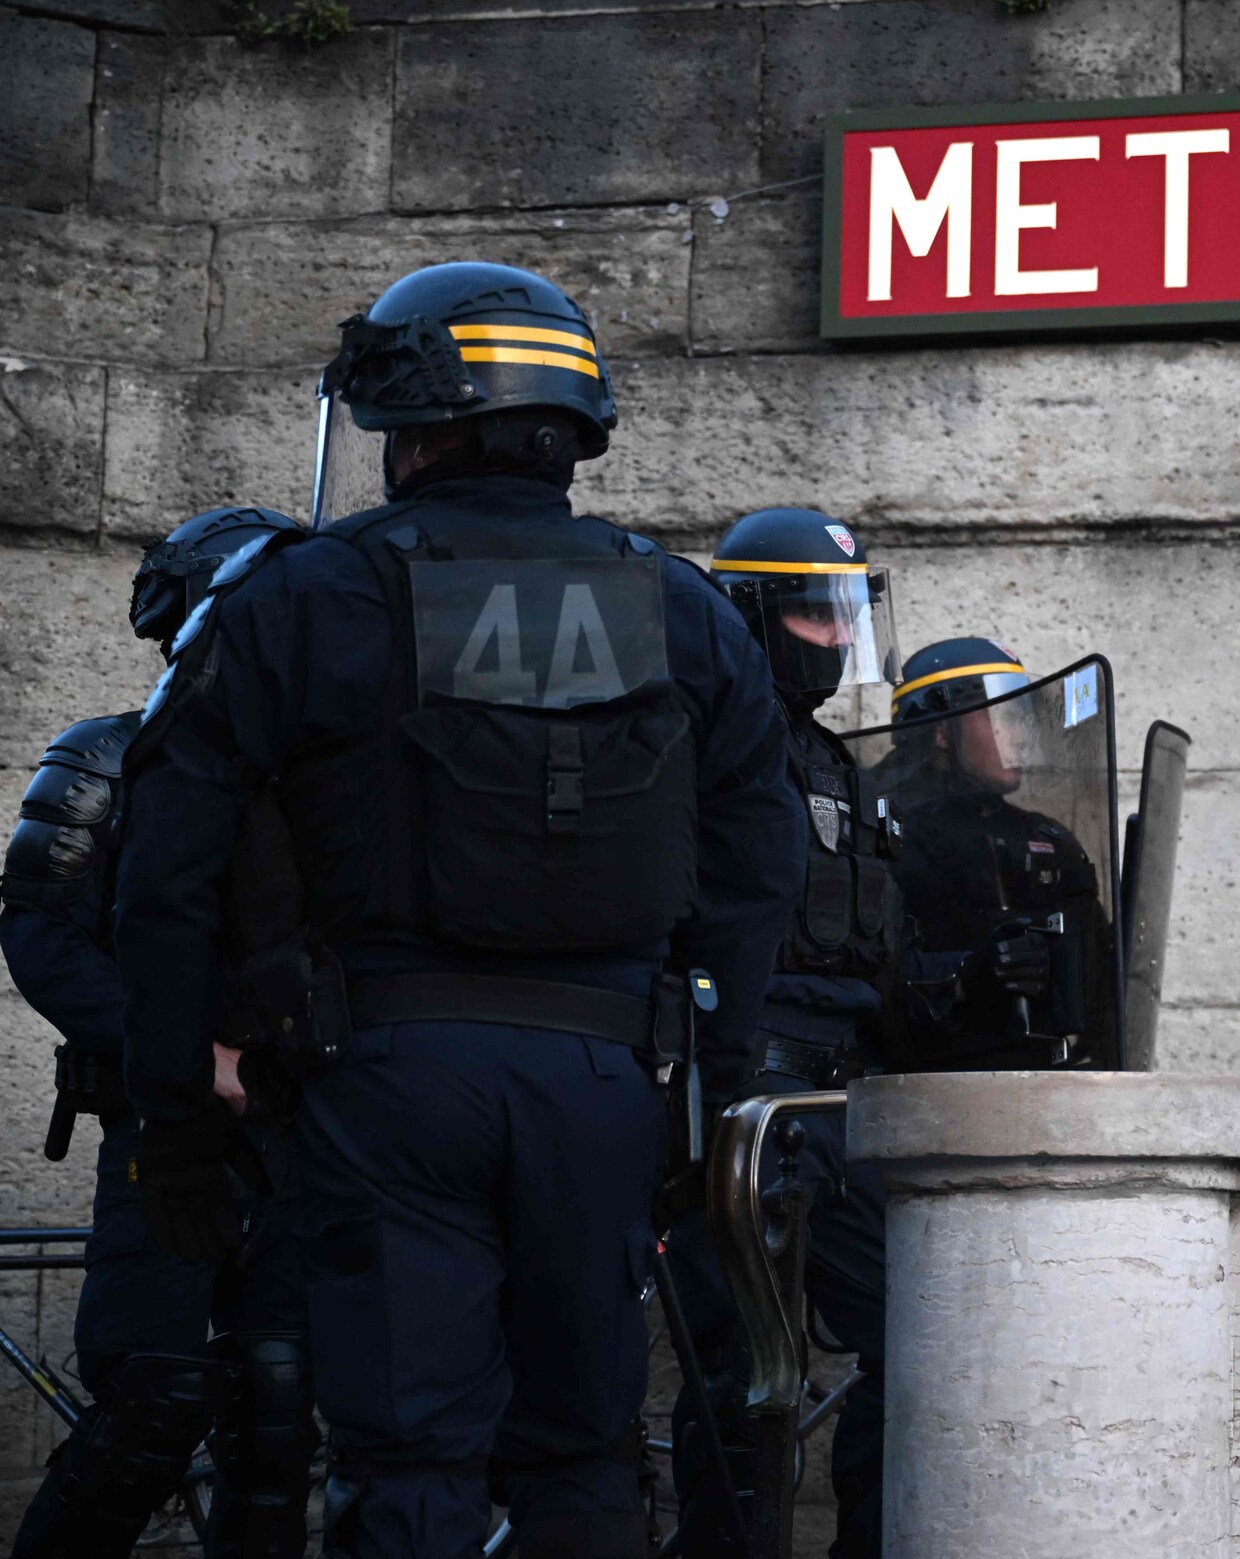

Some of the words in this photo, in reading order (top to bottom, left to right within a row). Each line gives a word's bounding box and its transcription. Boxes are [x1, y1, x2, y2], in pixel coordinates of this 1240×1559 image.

[453, 584, 628, 710] 4A
[814, 799, 834, 807] POLICE
[817, 813, 837, 828] CRS
